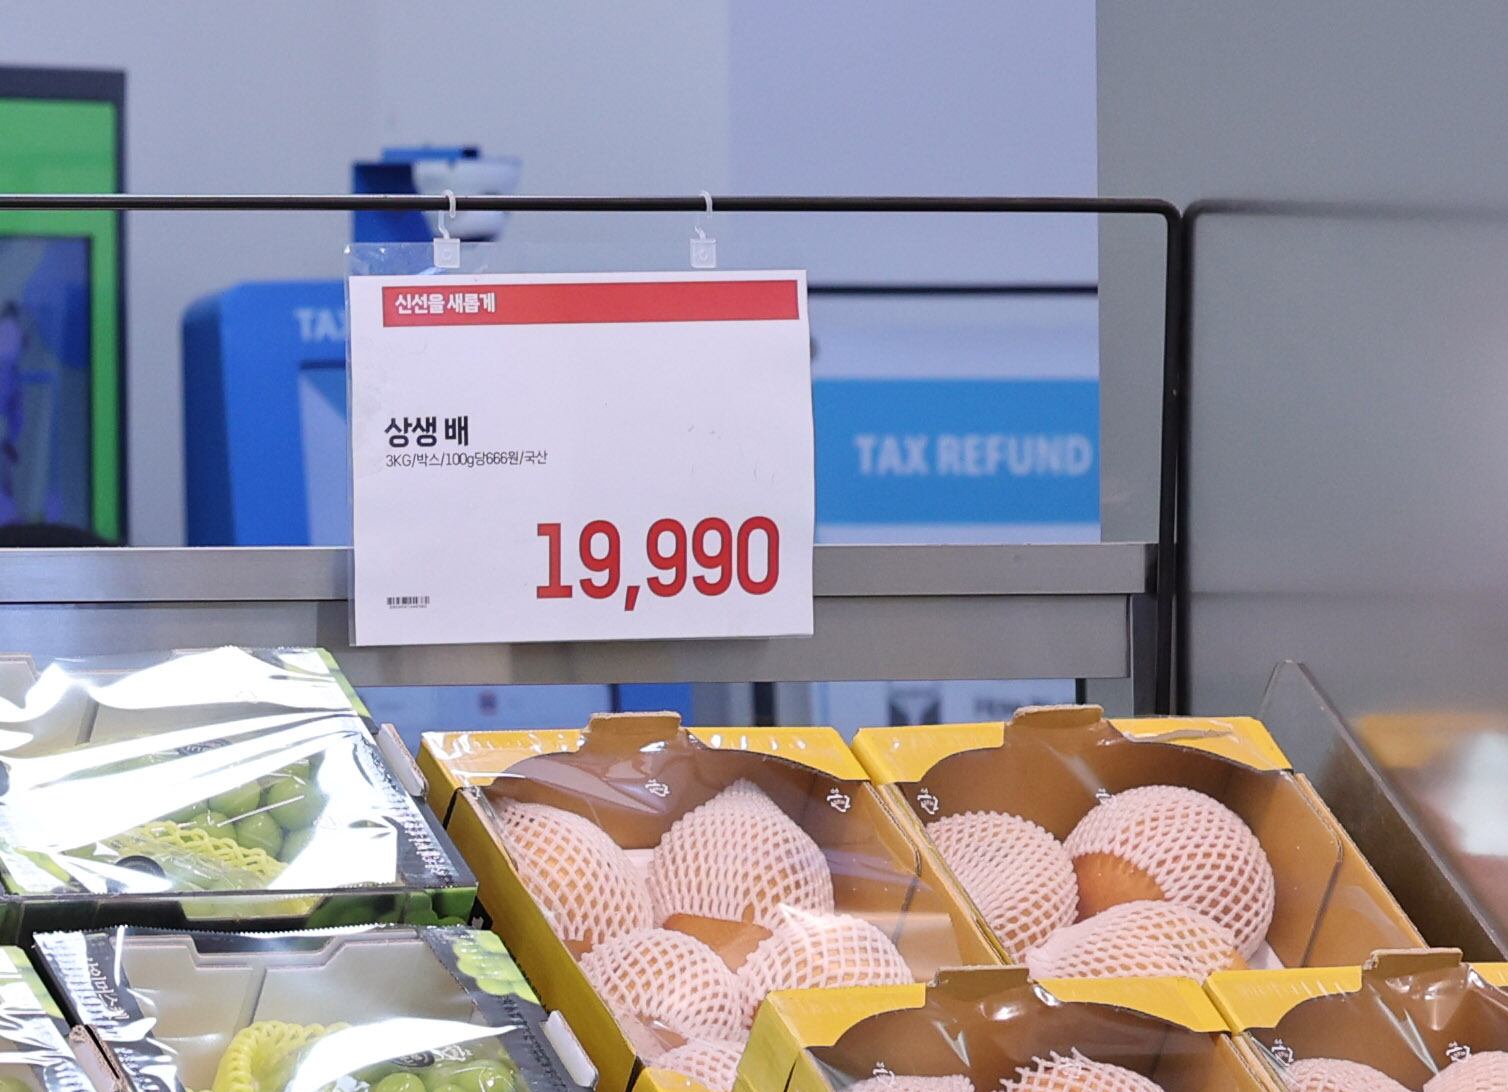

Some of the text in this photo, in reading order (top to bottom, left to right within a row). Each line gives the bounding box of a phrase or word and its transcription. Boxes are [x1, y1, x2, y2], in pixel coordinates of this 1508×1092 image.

[394, 292, 496, 315] 신선을 새롭게
[384, 415, 469, 448] 상생 배
[855, 435, 1094, 477] TAX REFUND
[536, 516, 780, 611] 19,990
